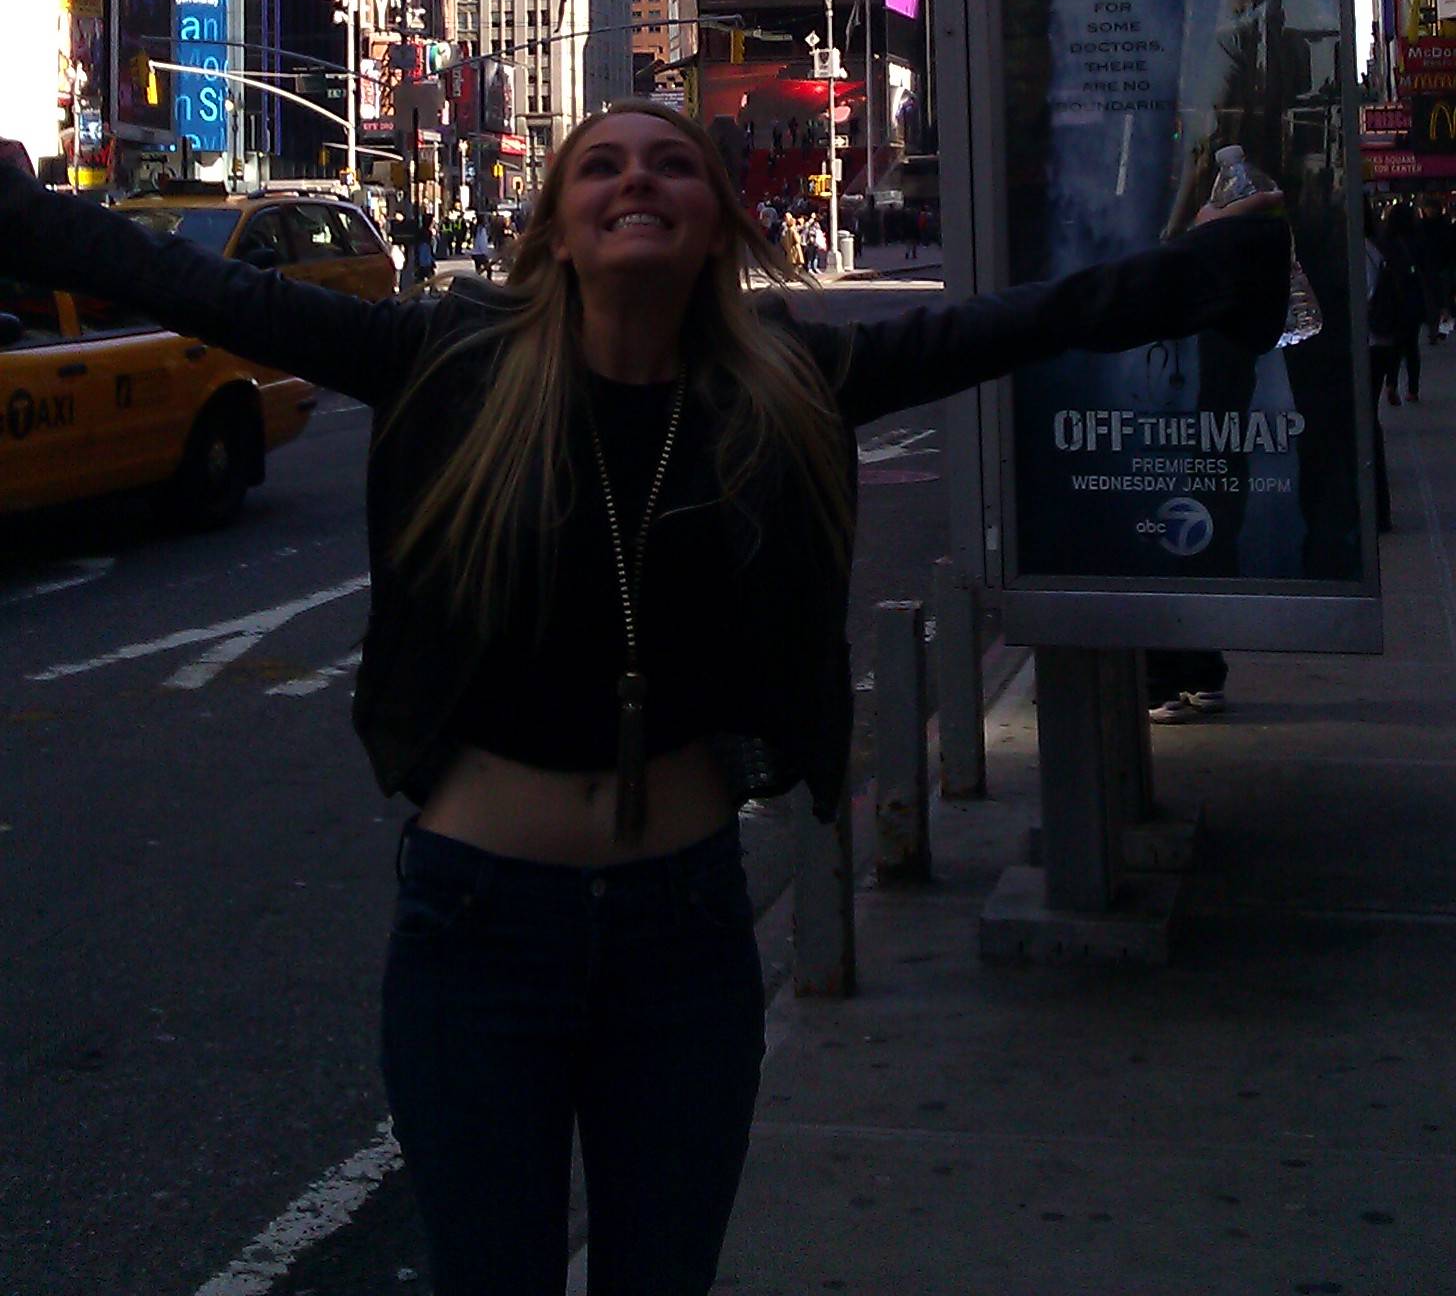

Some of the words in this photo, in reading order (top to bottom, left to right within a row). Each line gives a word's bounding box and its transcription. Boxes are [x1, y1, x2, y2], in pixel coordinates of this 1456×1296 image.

[1094, 1, 1131, 13] FOR
[1087, 21, 1141, 33] SOME
[1070, 40, 1165, 54] DOCTORS,
[1084, 60, 1148, 72] THERE
[1082, 81, 1117, 92] ARE
[1123, 80, 1150, 92] NO
[1053, 410, 1135, 453] OFF
[1137, 417, 1197, 446] THE
[1200, 410, 1306, 454] MAP
[1132, 458, 1228, 474] PREMIERES
[1072, 475, 1177, 492] WEDNESDAY
[1182, 476, 1217, 492] JAN
[1222, 476, 1239, 492] 12
[1248, 476, 1292, 493] 10PM
[1136, 519, 1167, 534] abc
